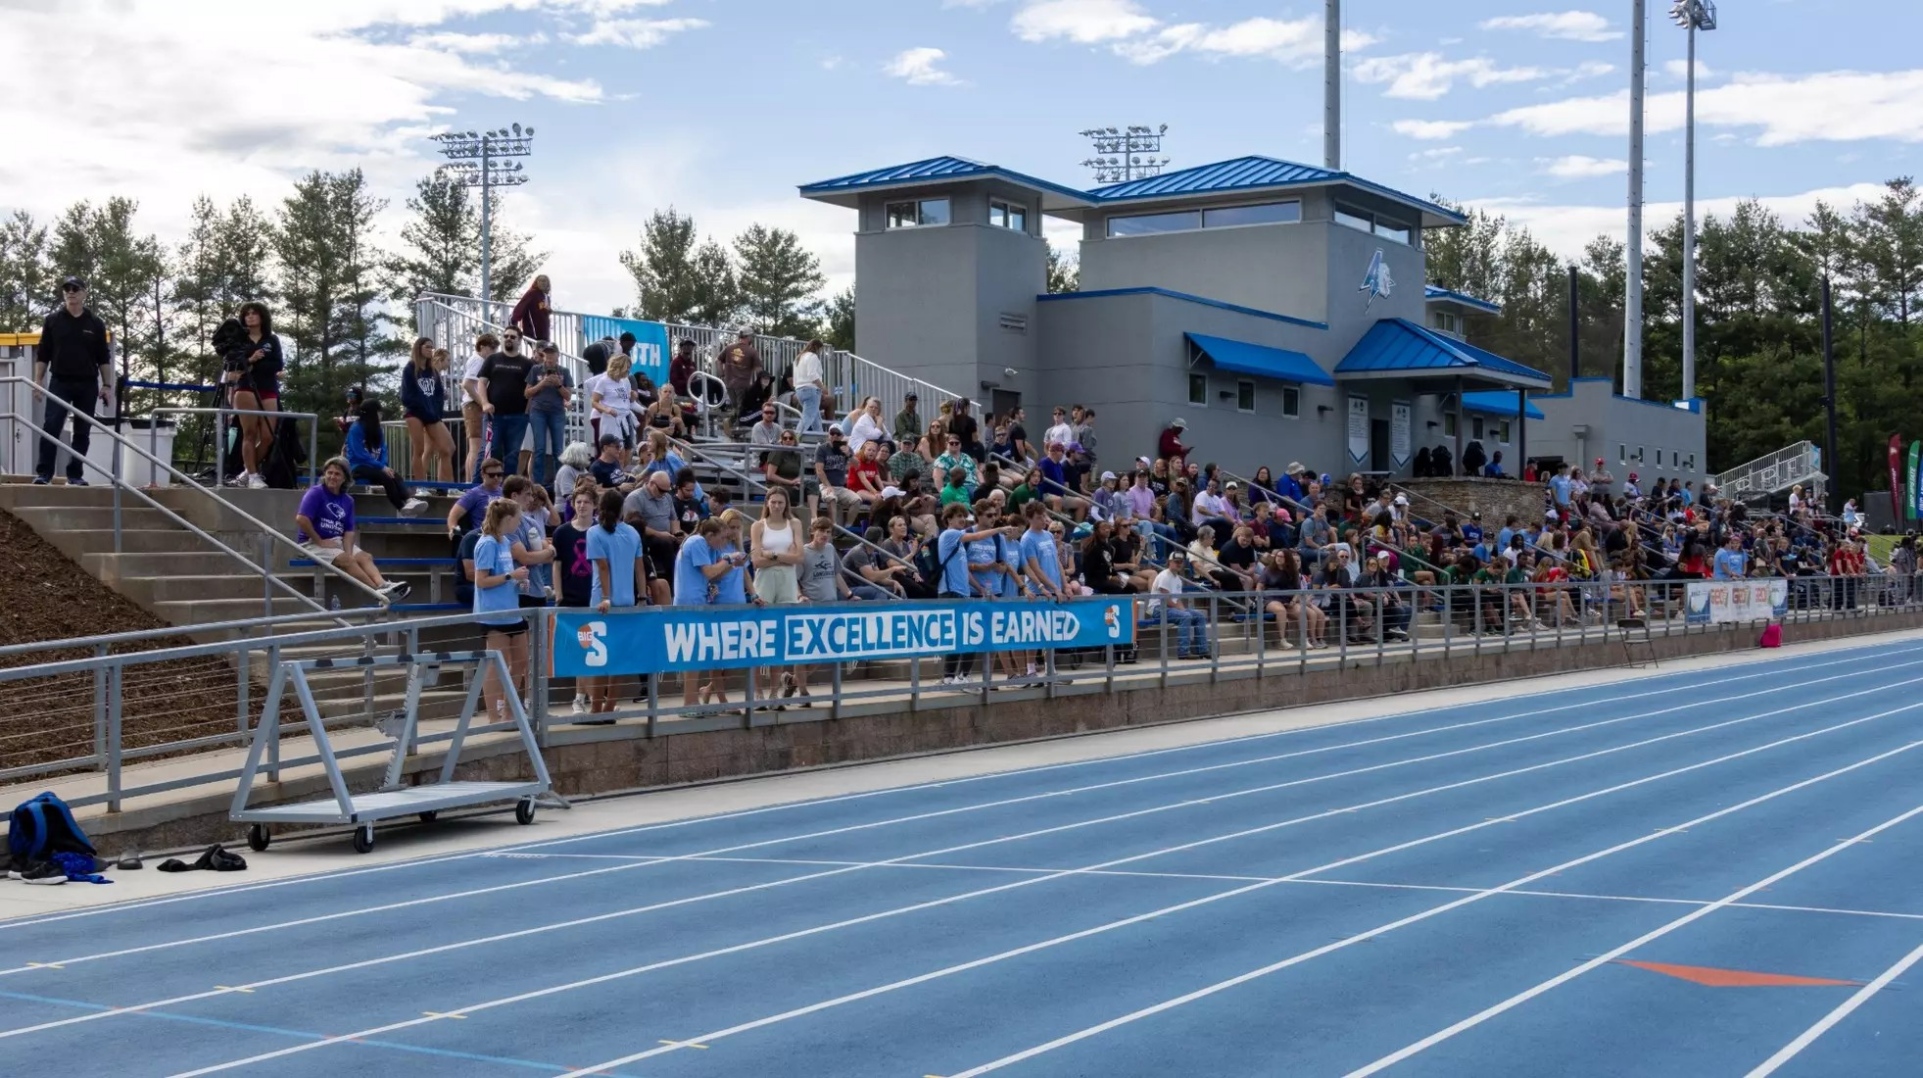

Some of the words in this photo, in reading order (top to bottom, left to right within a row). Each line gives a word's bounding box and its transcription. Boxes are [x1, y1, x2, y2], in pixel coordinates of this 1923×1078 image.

[630, 342, 661, 367] UTH
[578, 631, 592, 642] BIG
[664, 620, 777, 663] WHERE
[788, 613, 954, 656] EXCELLENCE
[962, 611, 985, 646] IS
[991, 610, 1080, 645] EARNED
[1109, 604, 1120, 638] S
[585, 621, 608, 667] S
